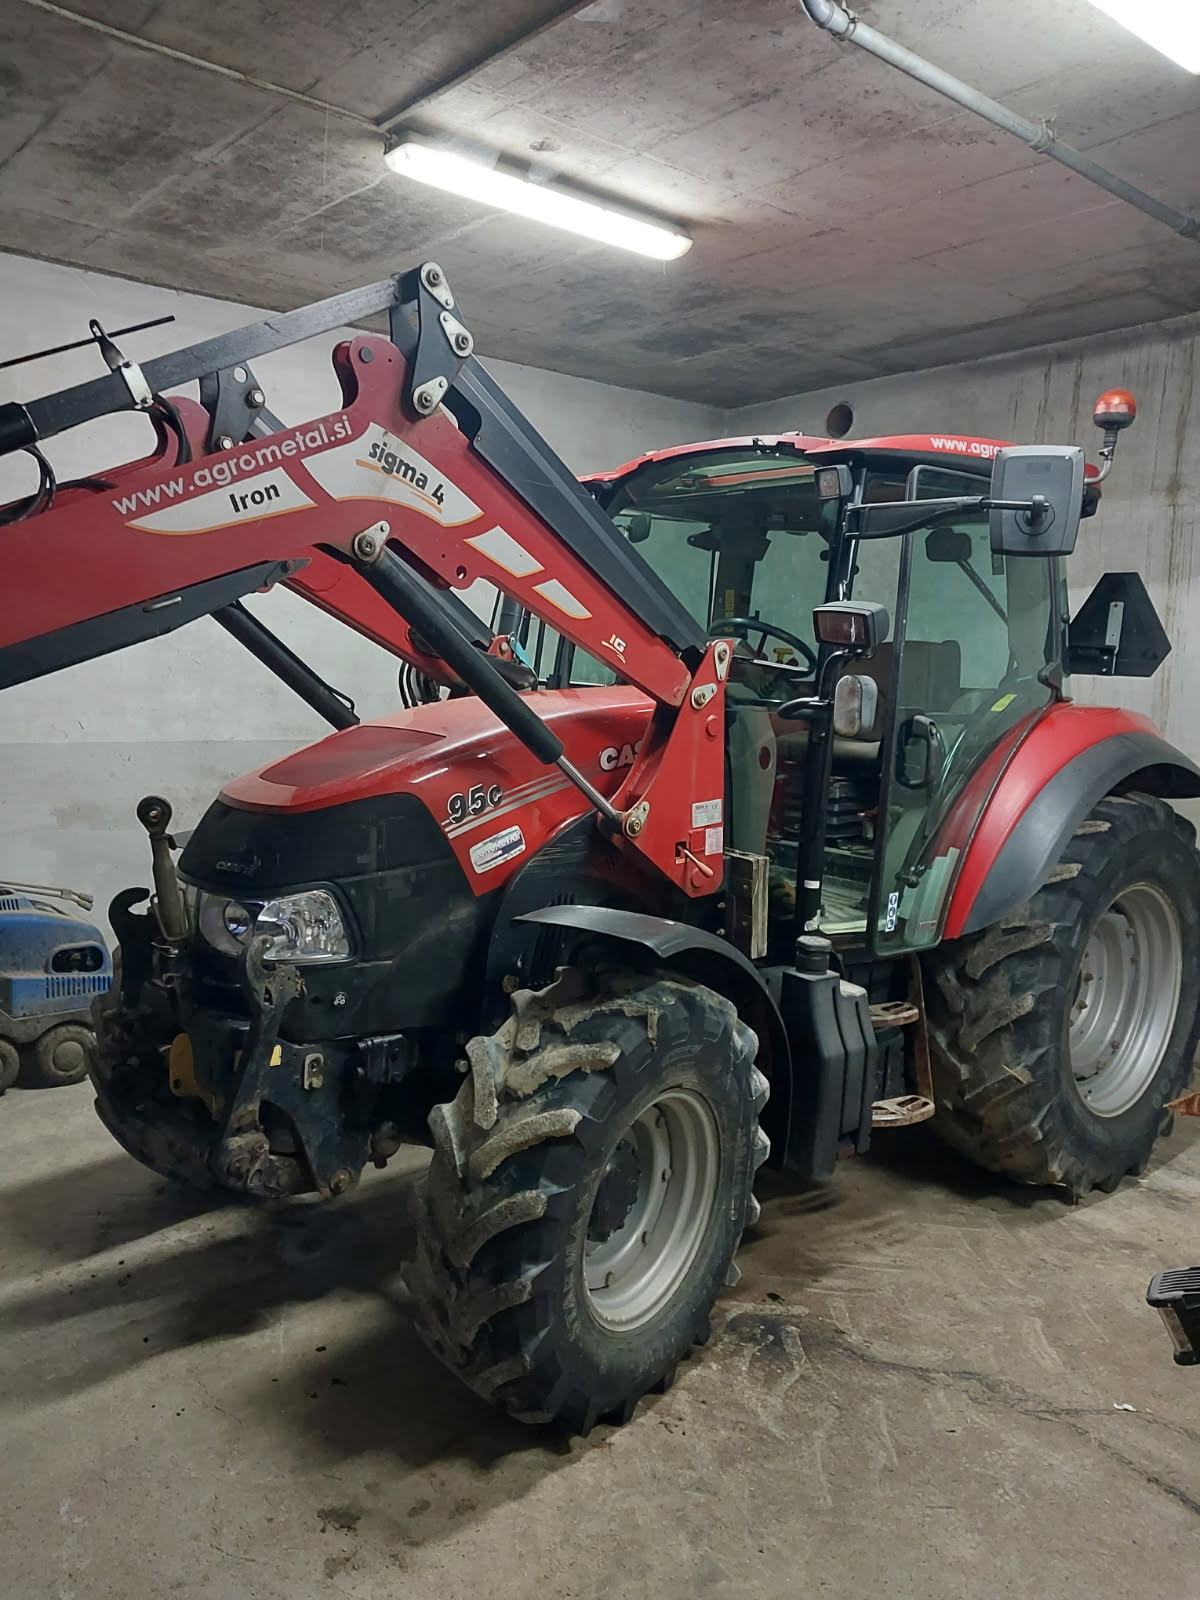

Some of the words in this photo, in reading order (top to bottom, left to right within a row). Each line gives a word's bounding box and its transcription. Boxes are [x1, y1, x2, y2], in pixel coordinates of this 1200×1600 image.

[112, 415, 353, 515] www.agrometal.si
[368, 441, 429, 490] sigma
[431, 483, 445, 506] 4
[228, 483, 281, 513] Iron
